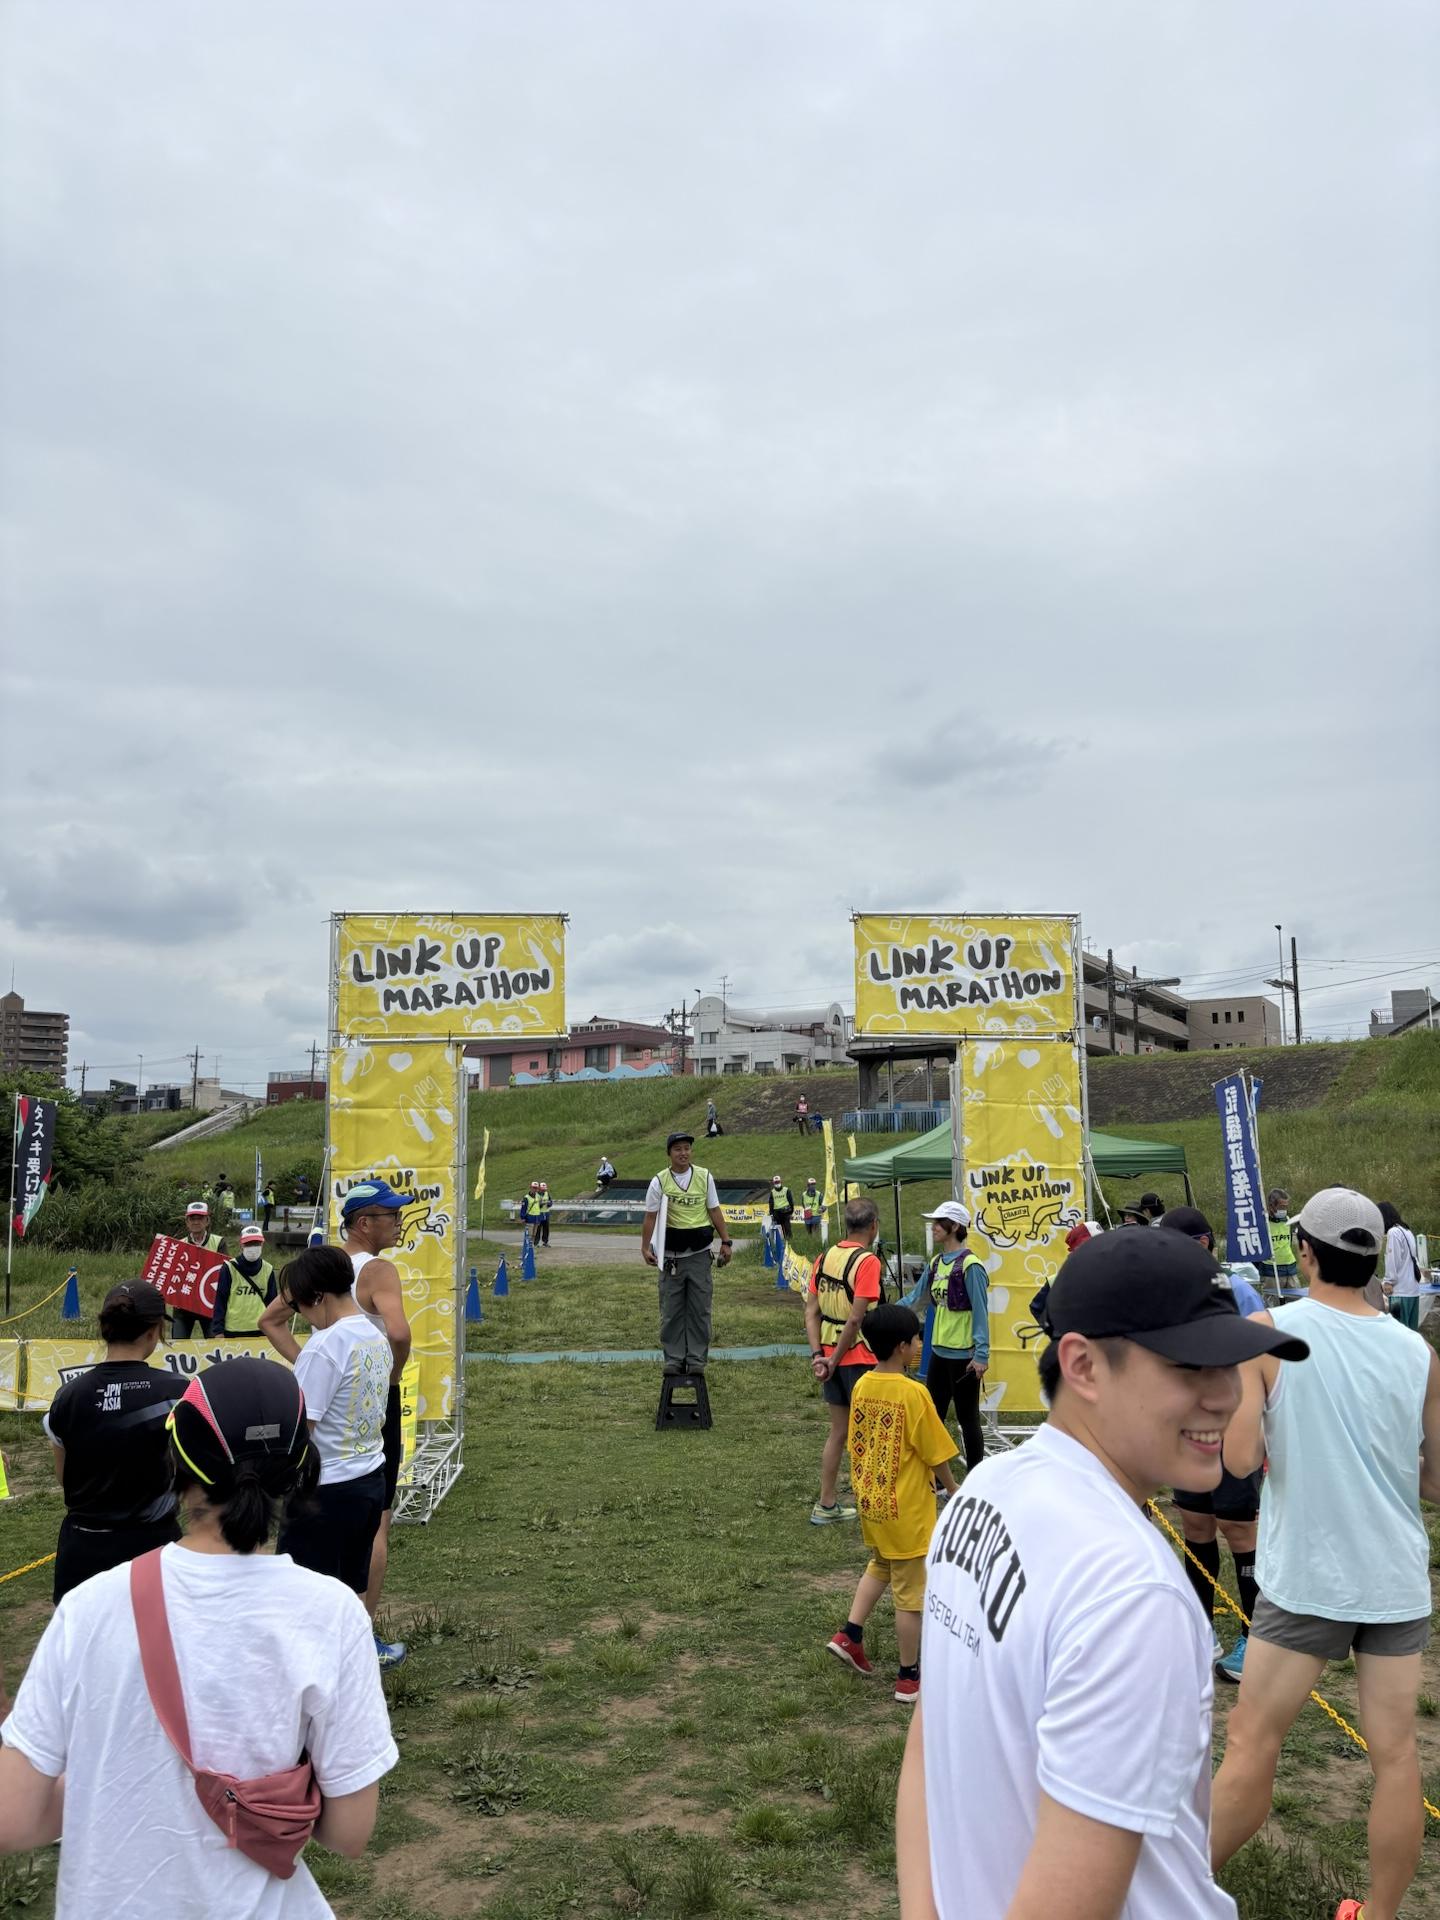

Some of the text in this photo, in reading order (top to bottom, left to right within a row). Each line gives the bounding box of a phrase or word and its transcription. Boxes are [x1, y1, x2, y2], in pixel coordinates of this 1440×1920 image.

[353, 937, 500, 982] LINK UP
[871, 938, 1011, 981] LINK UP
[383, 968, 550, 1012] MARATHON
[900, 970, 1061, 1010] MARATHON
[390, 1170, 414, 1188] UP
[970, 1165, 1045, 1189] LINK UP
[987, 1182, 1071, 1204] MARATHON
[146, 1235, 168, 1283] ARATHON
[162, 1242, 180, 1269] BACK
[166, 1251, 189, 1295] マラソン
[180, 1261, 201, 1295] 折返し
[102, 1397, 121, 1411] ASIA
[104, 1383, 121, 1397] JPN
